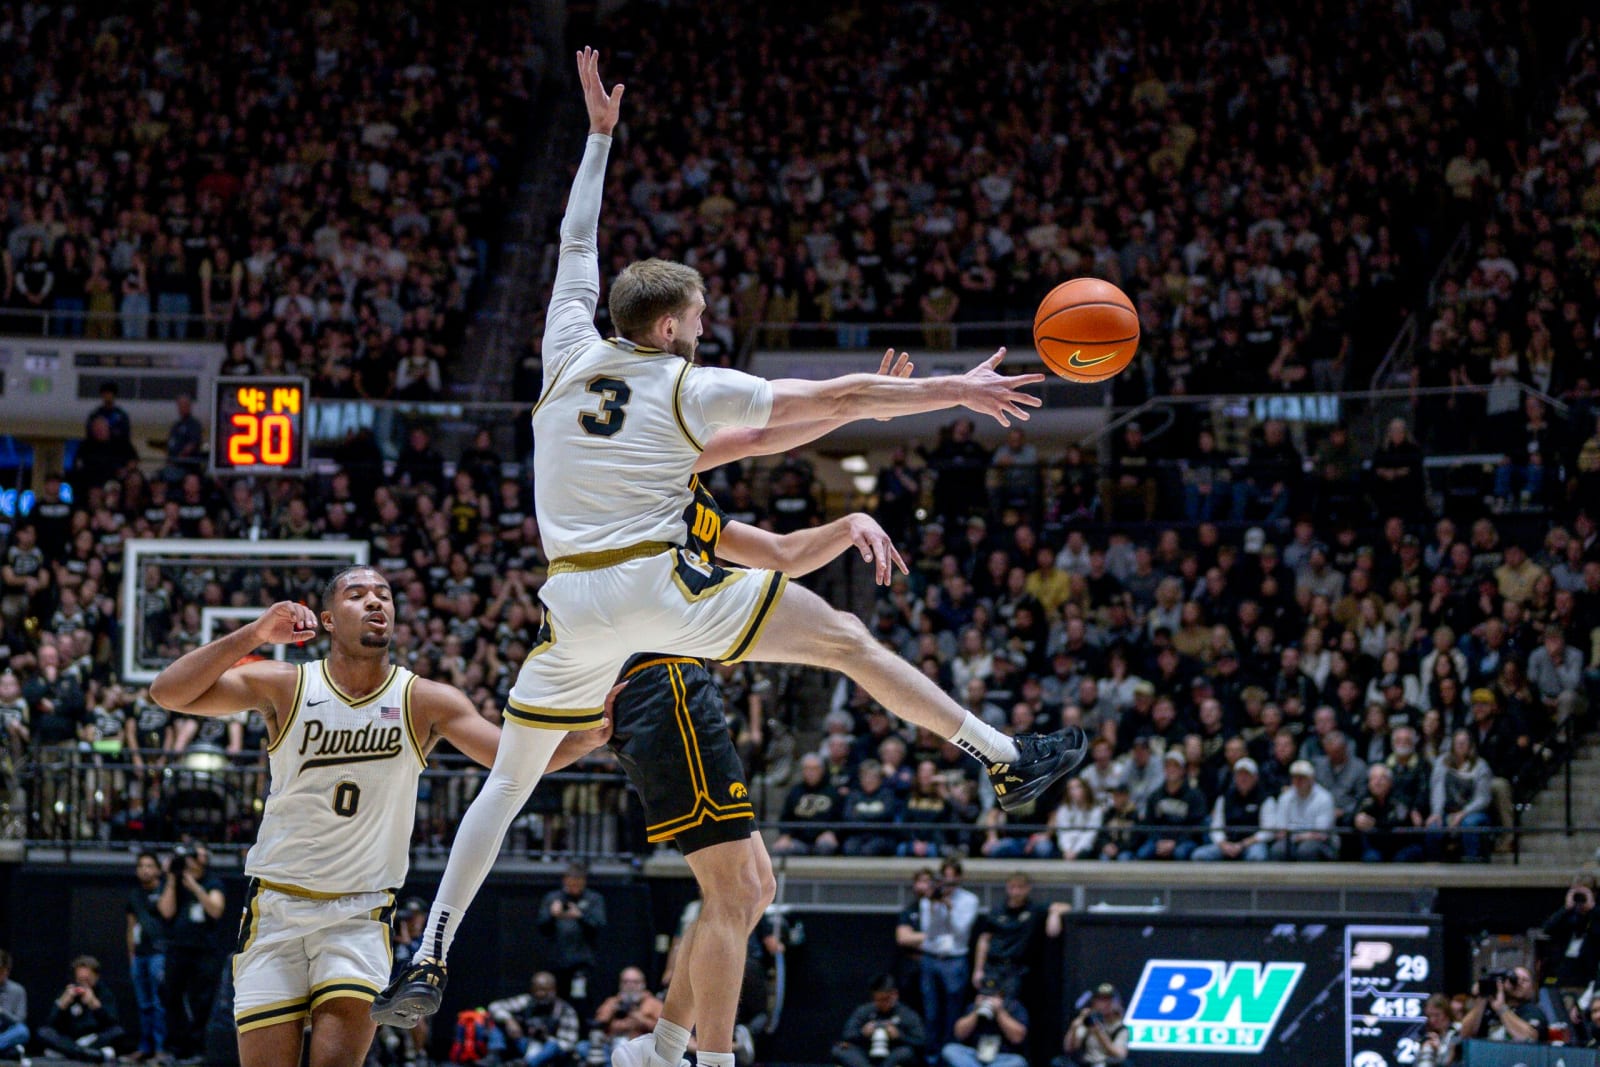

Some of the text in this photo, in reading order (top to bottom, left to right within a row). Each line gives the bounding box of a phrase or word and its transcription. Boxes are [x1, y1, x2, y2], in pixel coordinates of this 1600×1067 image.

[238, 387, 300, 414] 4:14
[578, 374, 632, 437] 3
[228, 413, 292, 465] 20
[691, 502, 721, 552] IO
[298, 719, 403, 757] Purdue
[332, 780, 361, 817] 0
[1395, 954, 1429, 982] 29
[1130, 965, 1297, 1024] BW
[1370, 997, 1421, 1018] 4:15
[1131, 1024, 1256, 1046] FUSION
